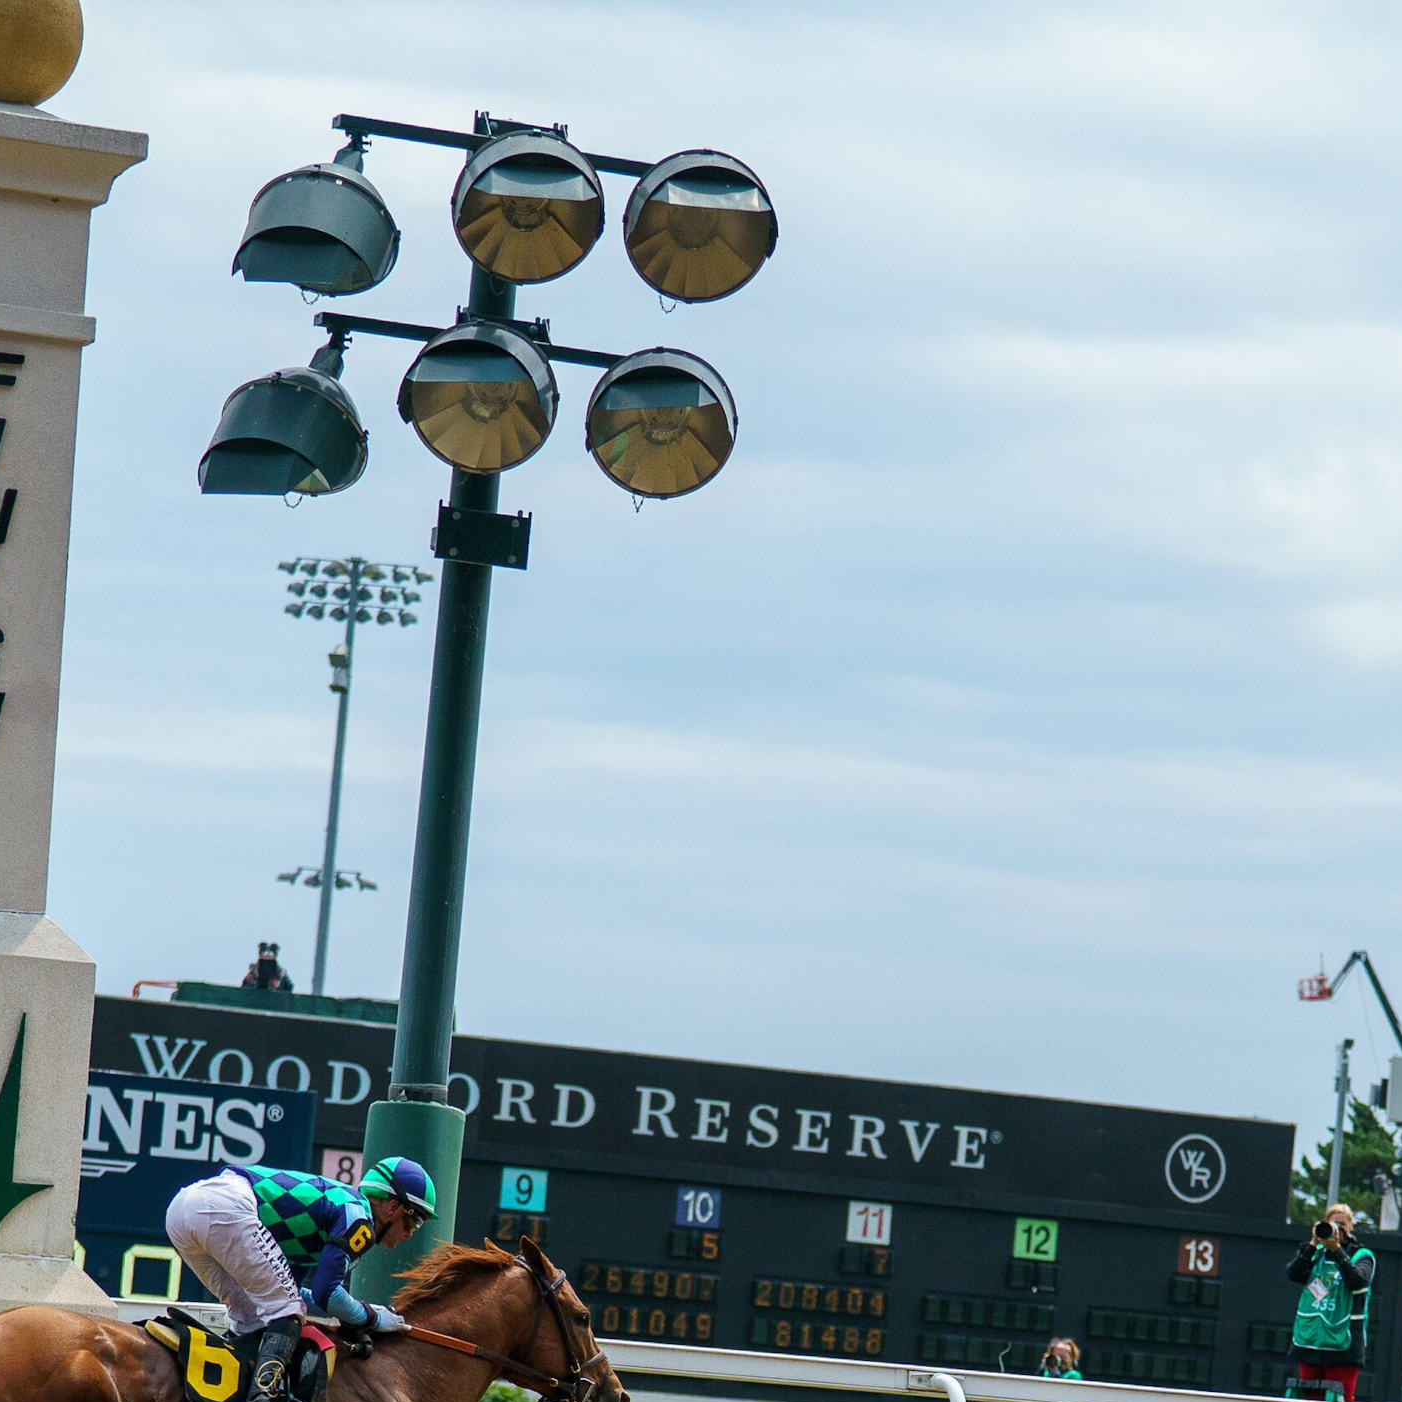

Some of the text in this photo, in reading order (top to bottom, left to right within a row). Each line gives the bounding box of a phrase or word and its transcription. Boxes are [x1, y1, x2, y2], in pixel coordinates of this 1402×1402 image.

[129, 1032, 596, 1129] WOODORD
[336, 1156, 355, 1185] 8
[515, 1174, 534, 1205] 9
[684, 1190, 714, 1224] 10
[856, 1206, 884, 1239] 11
[349, 1224, 372, 1253] 6
[702, 1233, 719, 1260] 5
[1022, 1225, 1052, 1255] 12
[1185, 1240, 1214, 1272] 13
[186, 1325, 240, 1402] 6
